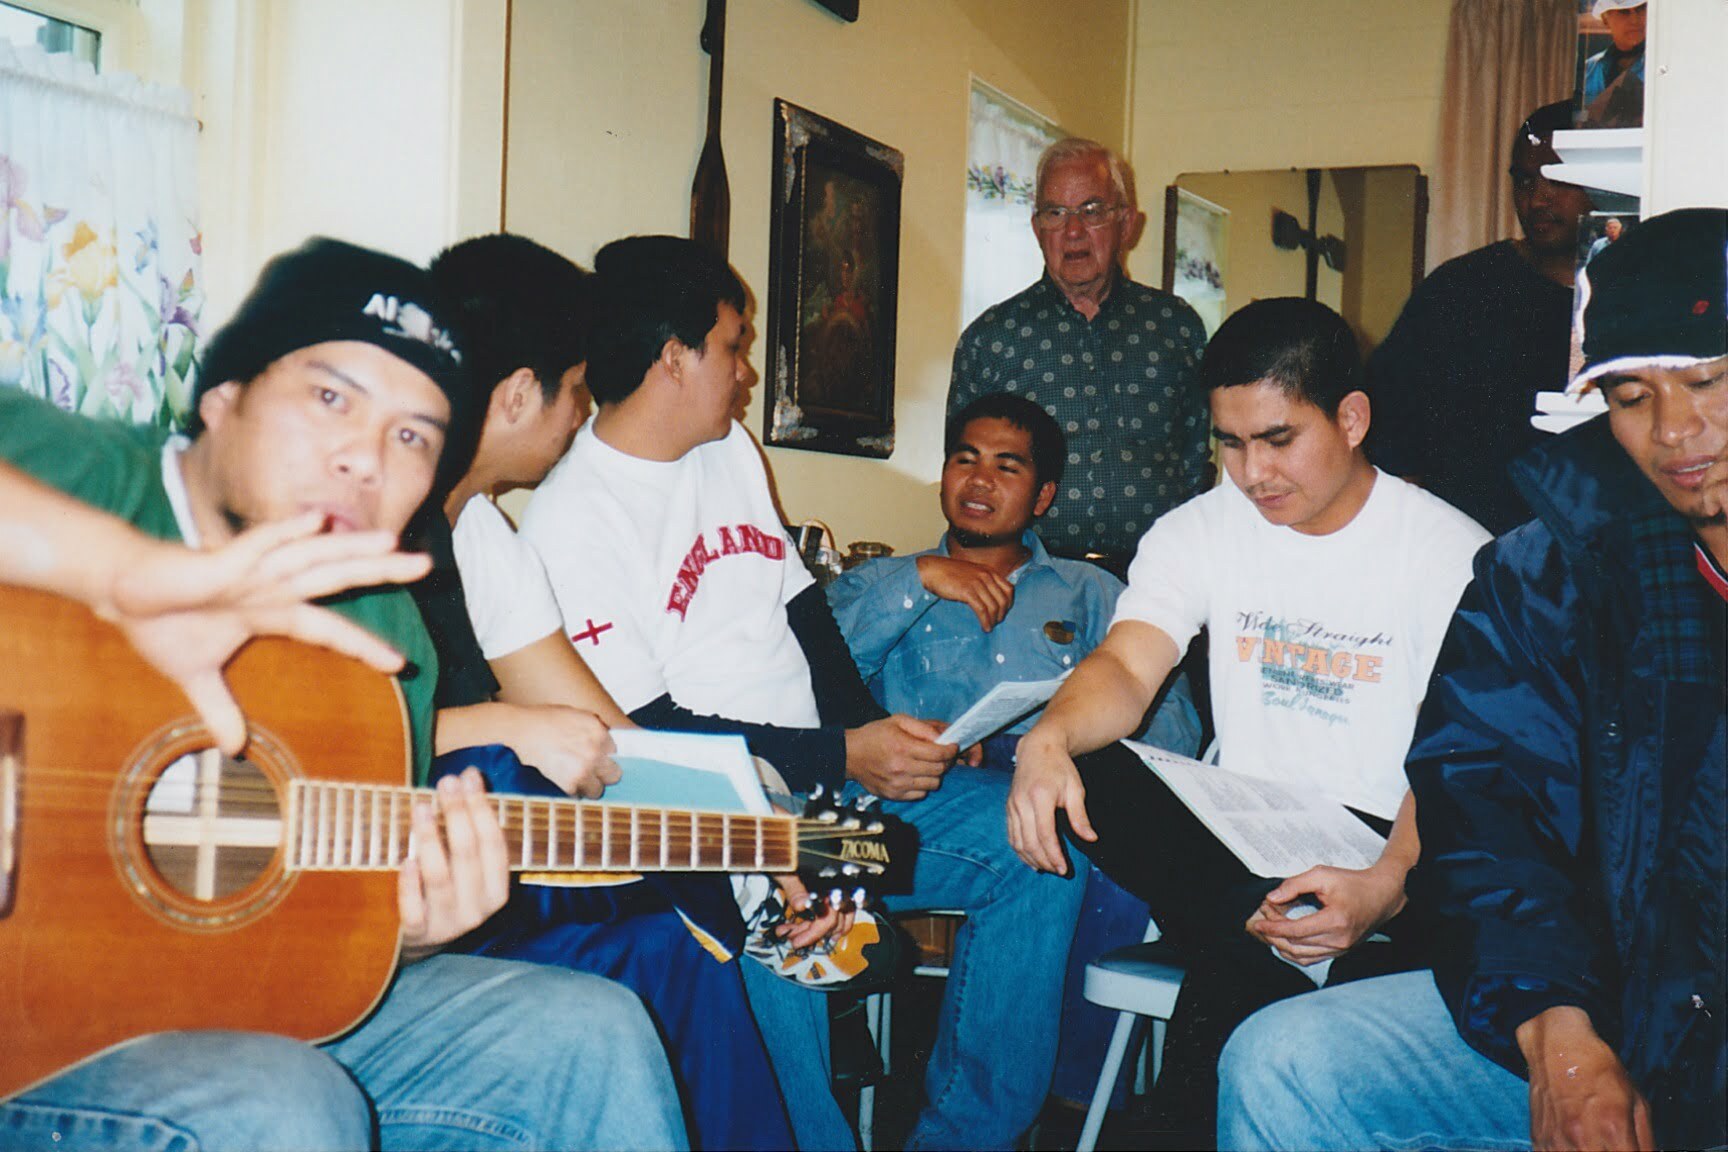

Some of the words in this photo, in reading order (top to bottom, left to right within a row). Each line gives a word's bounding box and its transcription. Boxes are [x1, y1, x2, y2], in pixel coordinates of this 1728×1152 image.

[1287, 617, 1393, 648] Straight
[1235, 635, 1384, 684] VNTAGE
[840, 839, 890, 863] TACOMA
